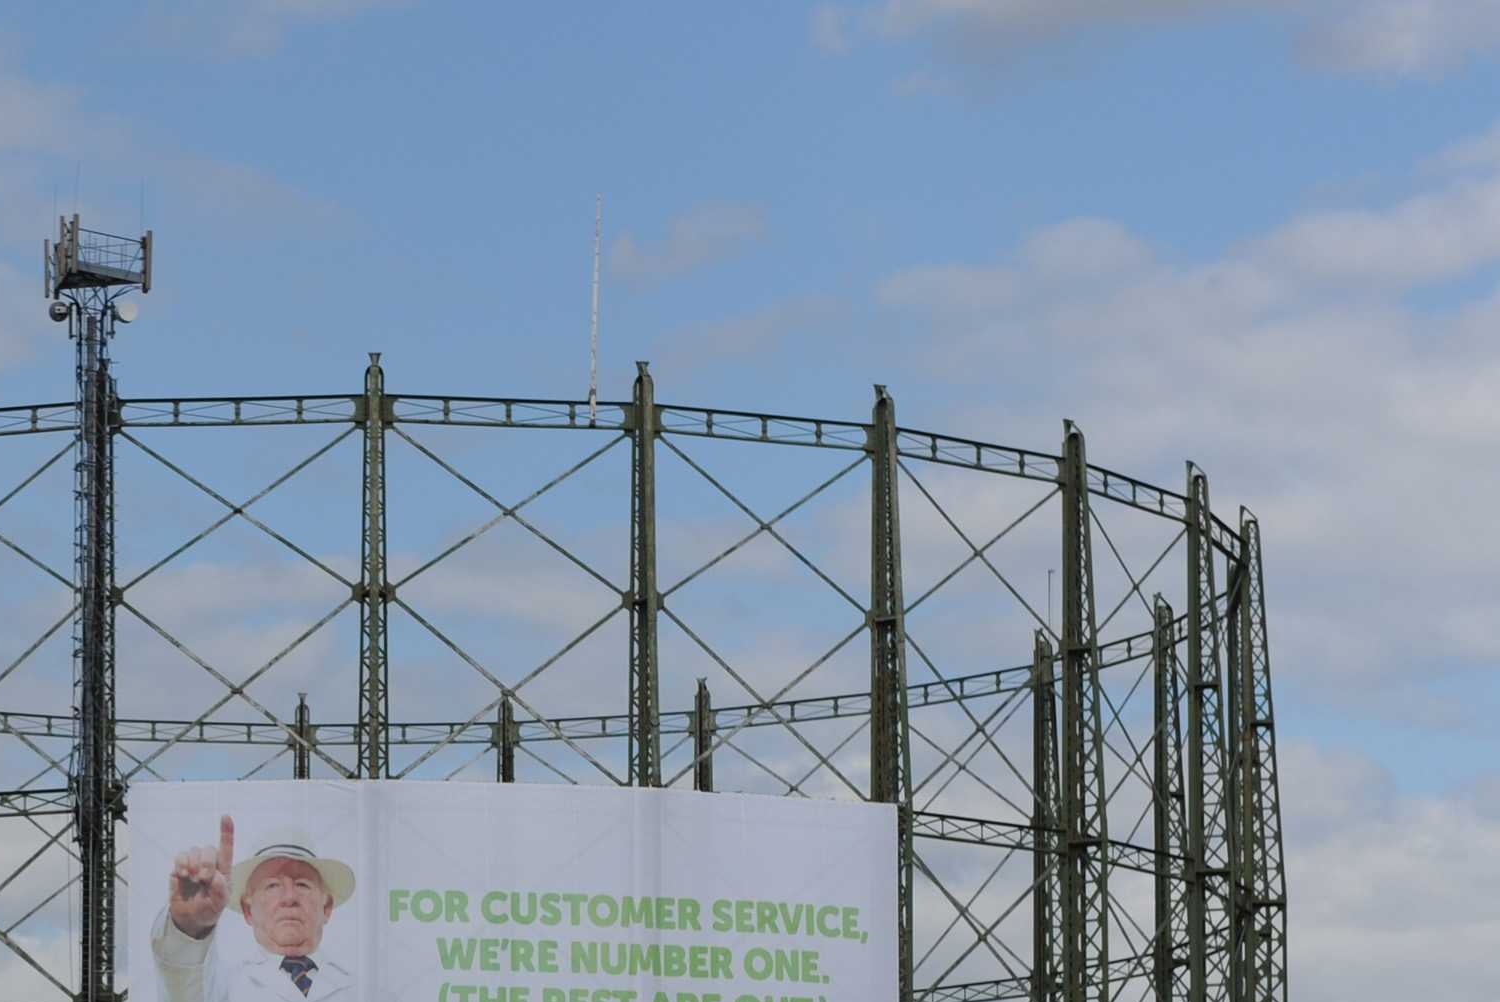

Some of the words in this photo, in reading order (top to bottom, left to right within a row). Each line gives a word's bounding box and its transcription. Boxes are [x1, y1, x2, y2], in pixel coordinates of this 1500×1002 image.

[388, 888, 469, 923] FOR
[480, 891, 702, 931] CUSTOMER
[711, 899, 869, 944] SERVICE,
[436, 936, 559, 973] WE'RE
[570, 941, 733, 980] NUMBER
[743, 948, 830, 985] ONE.
